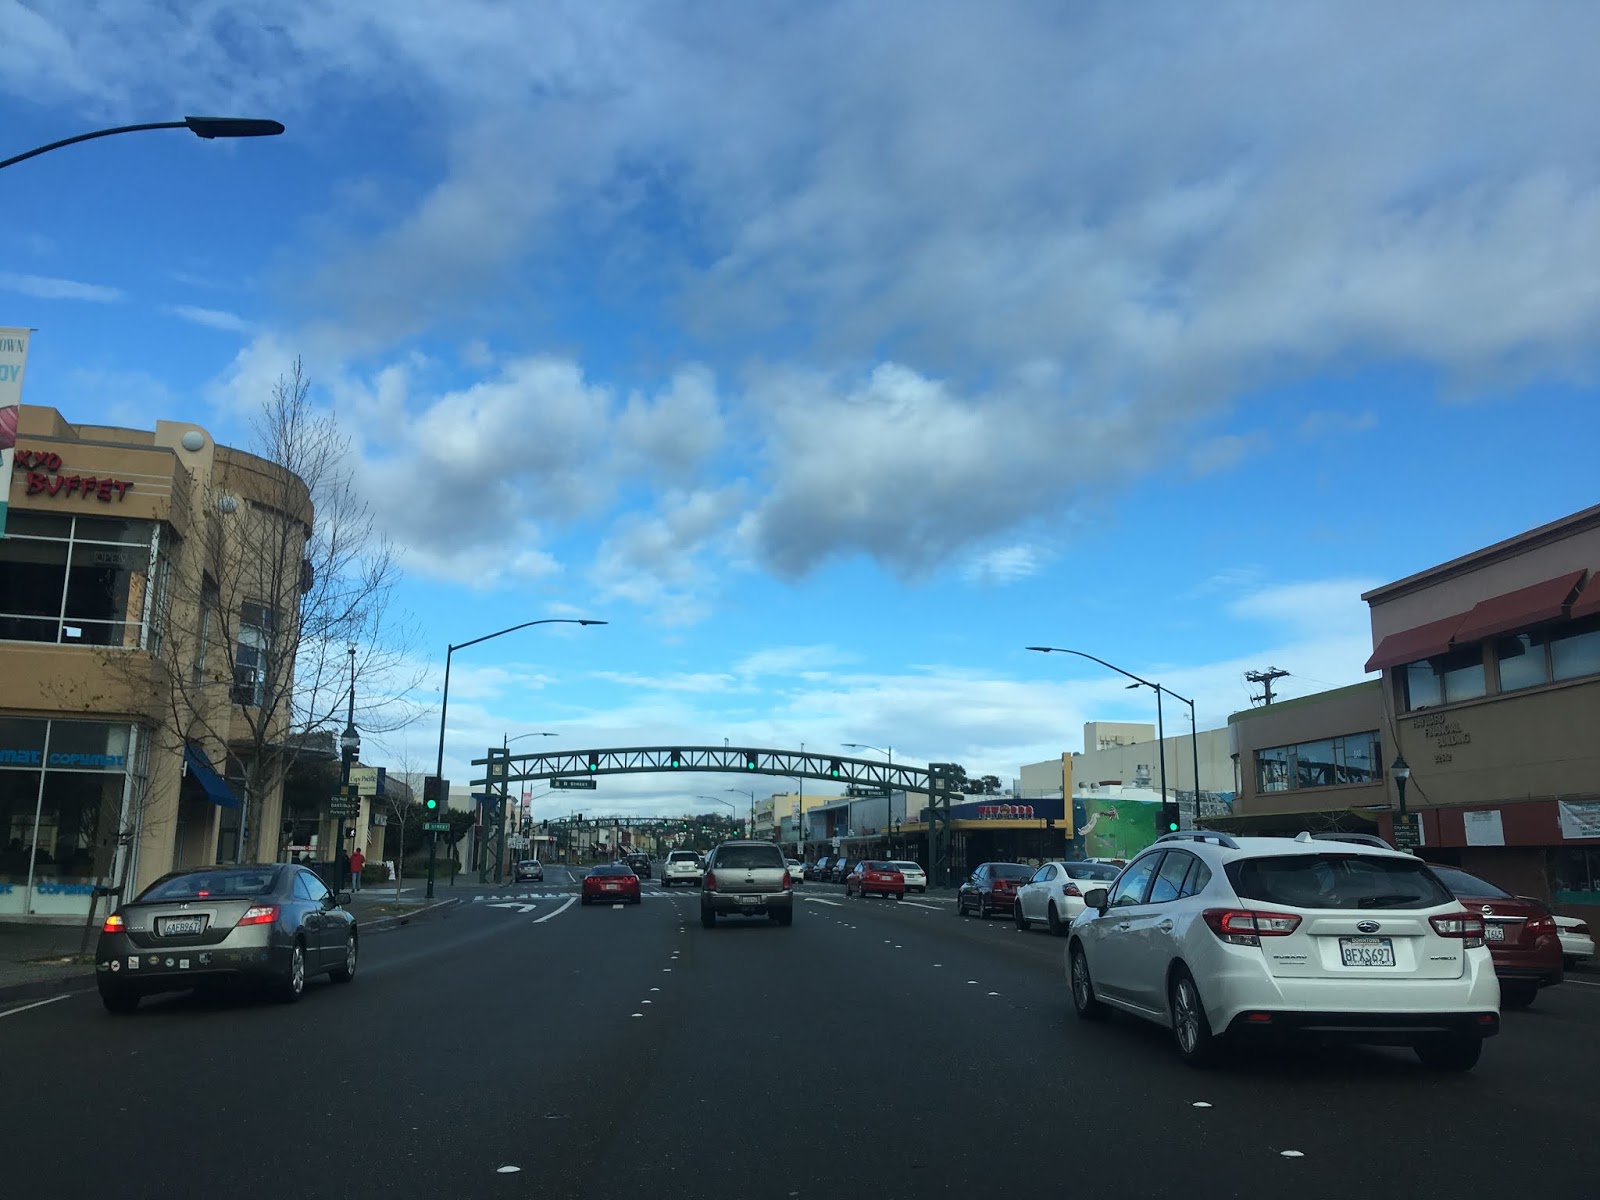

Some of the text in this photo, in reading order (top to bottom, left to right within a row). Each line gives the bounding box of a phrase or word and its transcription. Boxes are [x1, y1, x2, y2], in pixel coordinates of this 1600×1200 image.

[13, 449, 62, 472] KYO
[25, 471, 134, 502] BUFFET
[1413, 713, 1444, 728] HAYWARD
[1425, 723, 1462, 737] FINANCIAL
[1437, 732, 1471, 748] BUILDING
[1344, 948, 1390, 962] 8FXS697
